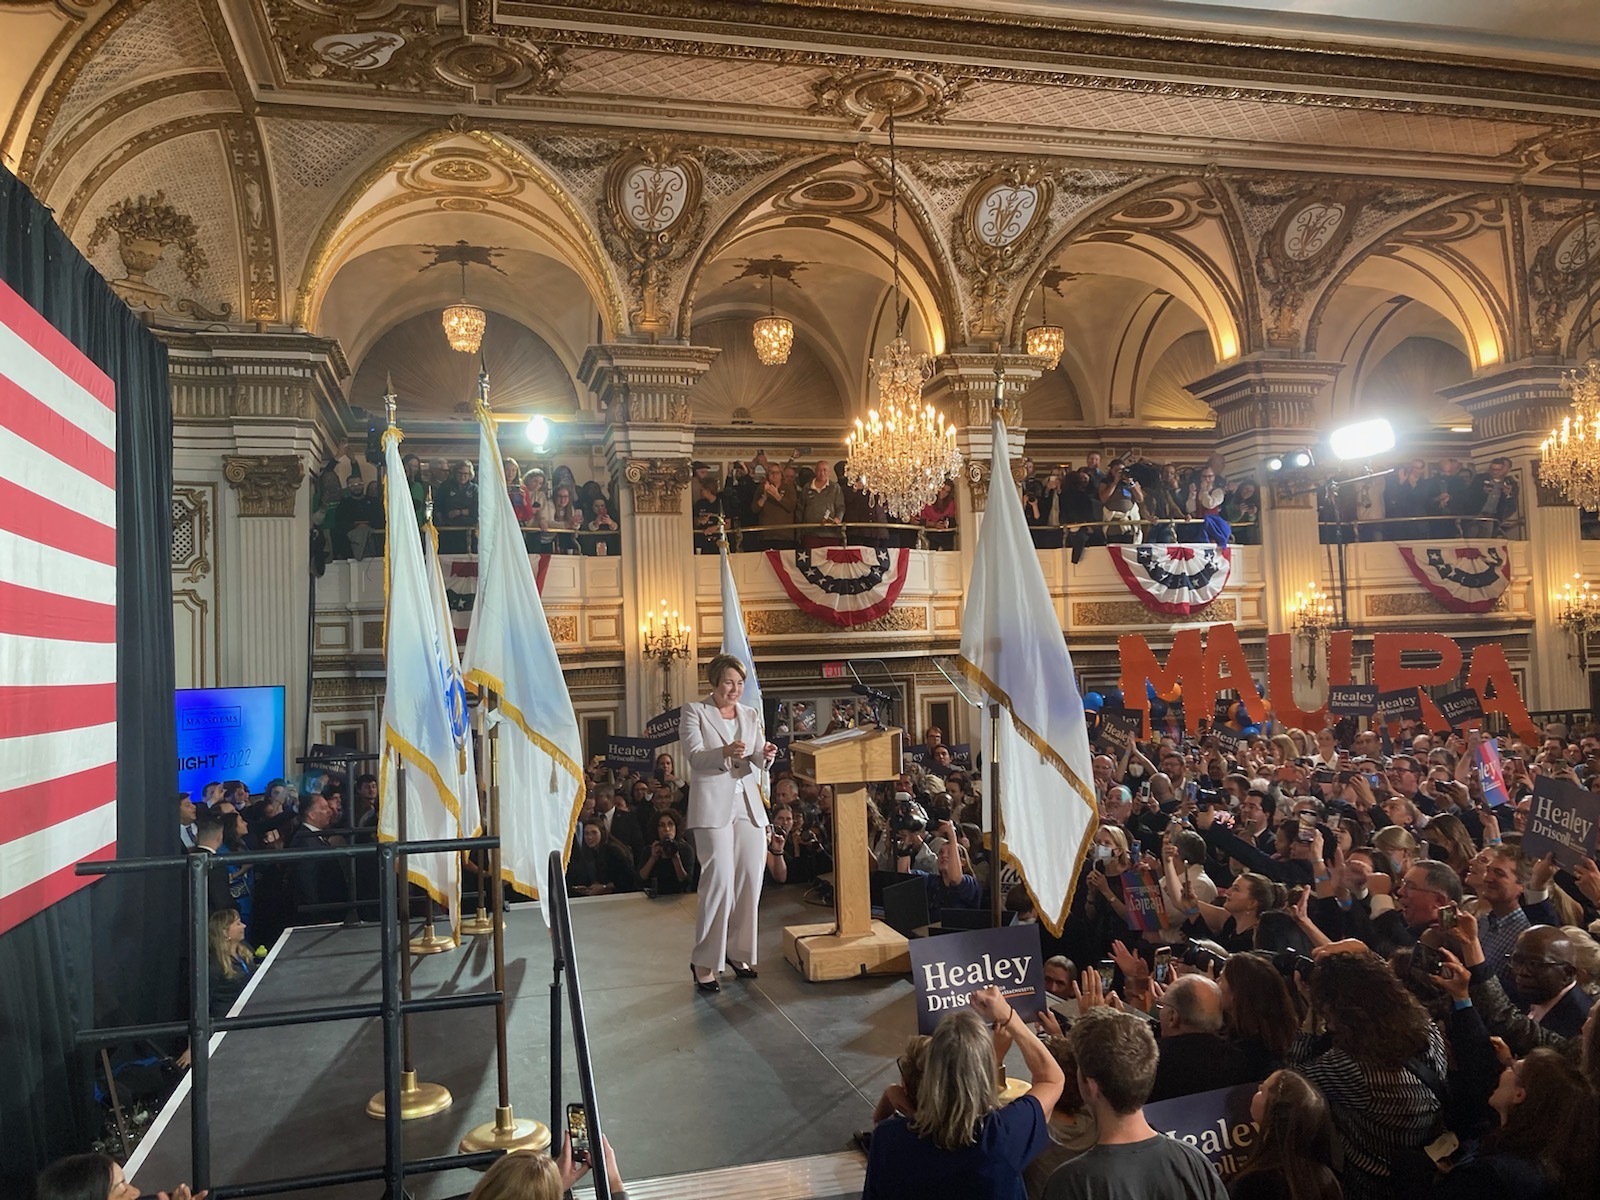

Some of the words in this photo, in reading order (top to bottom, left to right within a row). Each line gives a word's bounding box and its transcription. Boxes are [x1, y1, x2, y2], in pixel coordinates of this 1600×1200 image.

[1332, 691, 1375, 704] Healey
[1377, 697, 1416, 711] Healey
[1443, 697, 1477, 713] Healey
[185, 715, 238, 726] MASSDEMS
[608, 743, 651, 759] Healey
[221, 748, 251, 771] 2022
[1535, 795, 1593, 842] Healey
[1532, 820, 1571, 847] Driscoll
[922, 953, 1032, 992] Healey
